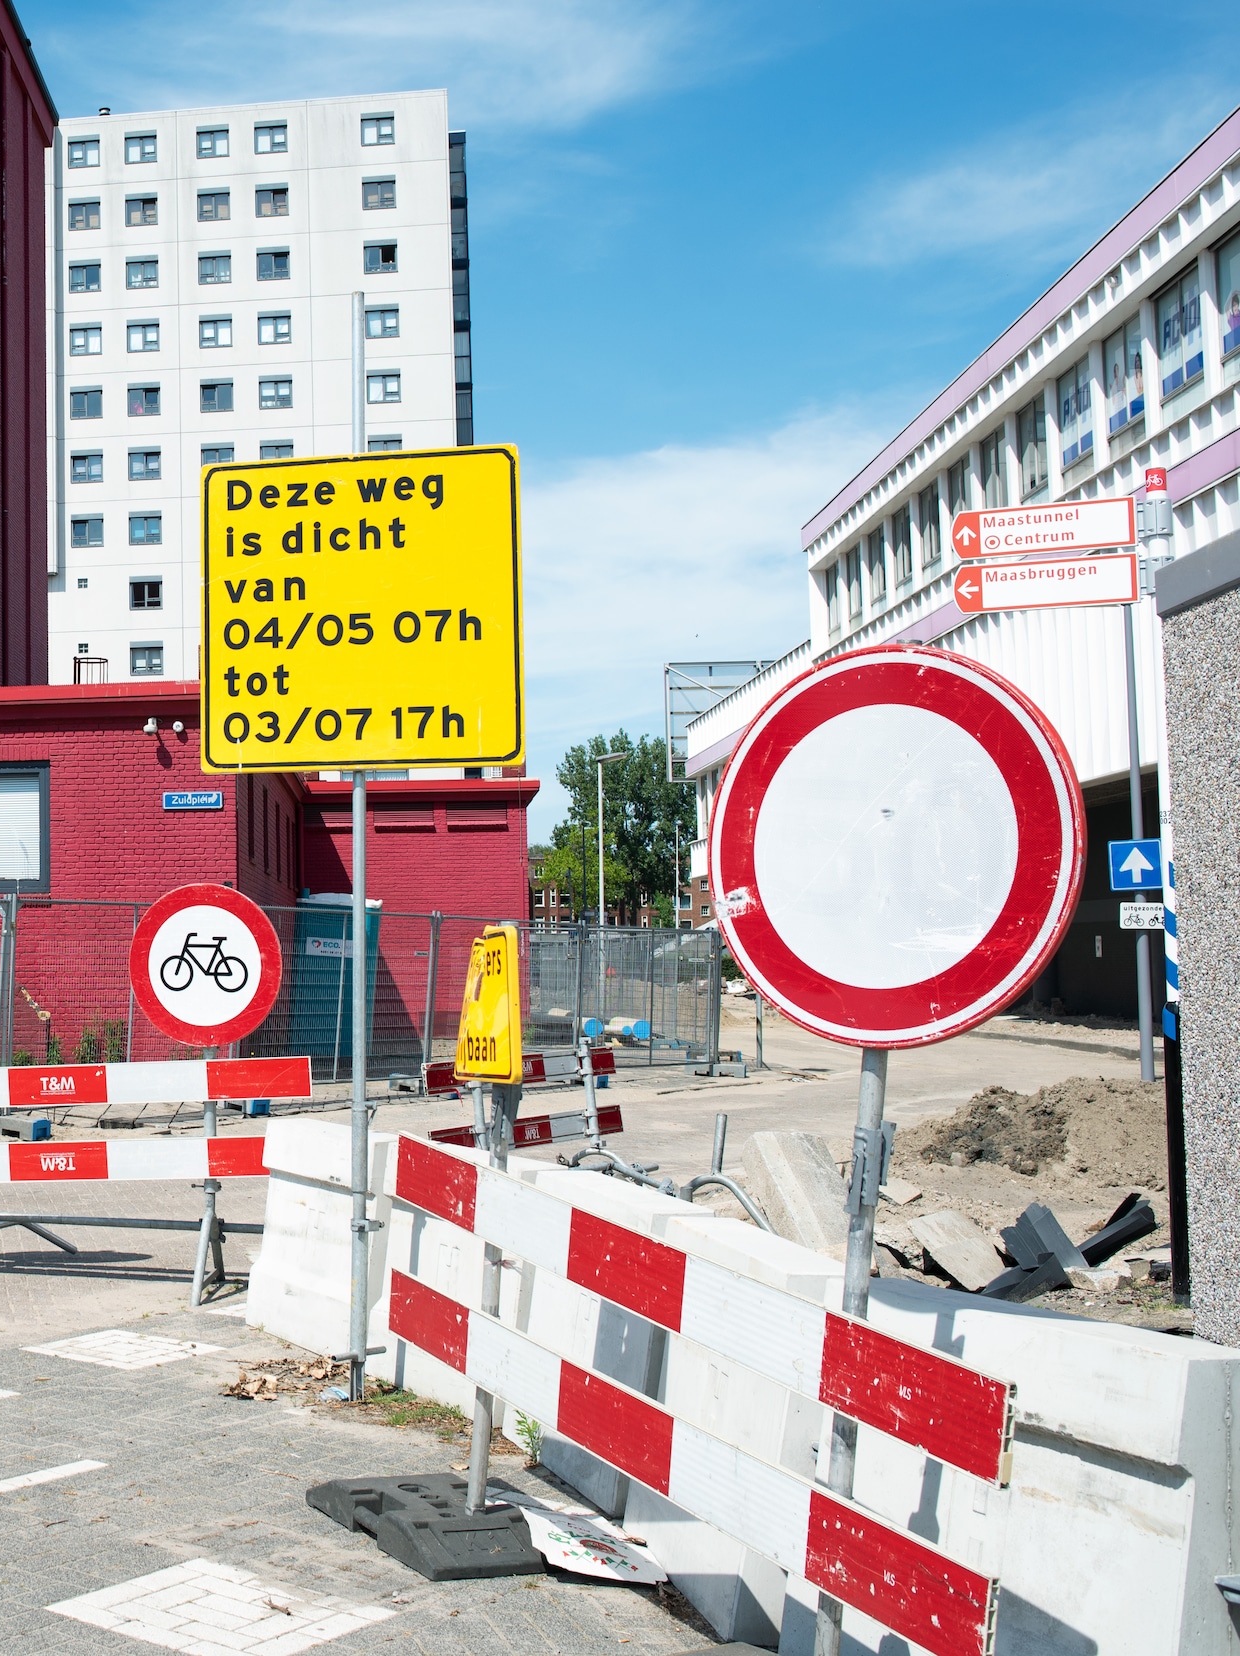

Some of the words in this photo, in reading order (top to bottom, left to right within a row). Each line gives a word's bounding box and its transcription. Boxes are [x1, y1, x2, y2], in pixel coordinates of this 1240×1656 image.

[227, 479, 335, 511] Deze
[357, 474, 443, 510] weg
[983, 508, 1079, 529] Maastunnel
[226, 526, 262, 557] is
[282, 517, 405, 554] dicht
[1004, 530, 1075, 546] Centrum
[985, 564, 1097, 583] Maasbruggen
[224, 576, 306, 603] van
[223, 612, 374, 650] 04/05
[393, 608, 482, 643] 07h
[224, 664, 290, 697] tot
[223, 707, 373, 744] 03/07
[391, 705, 465, 739] 17h
[40, 1076, 76, 1091] T&M
[40, 1157, 76, 1172] T&M
